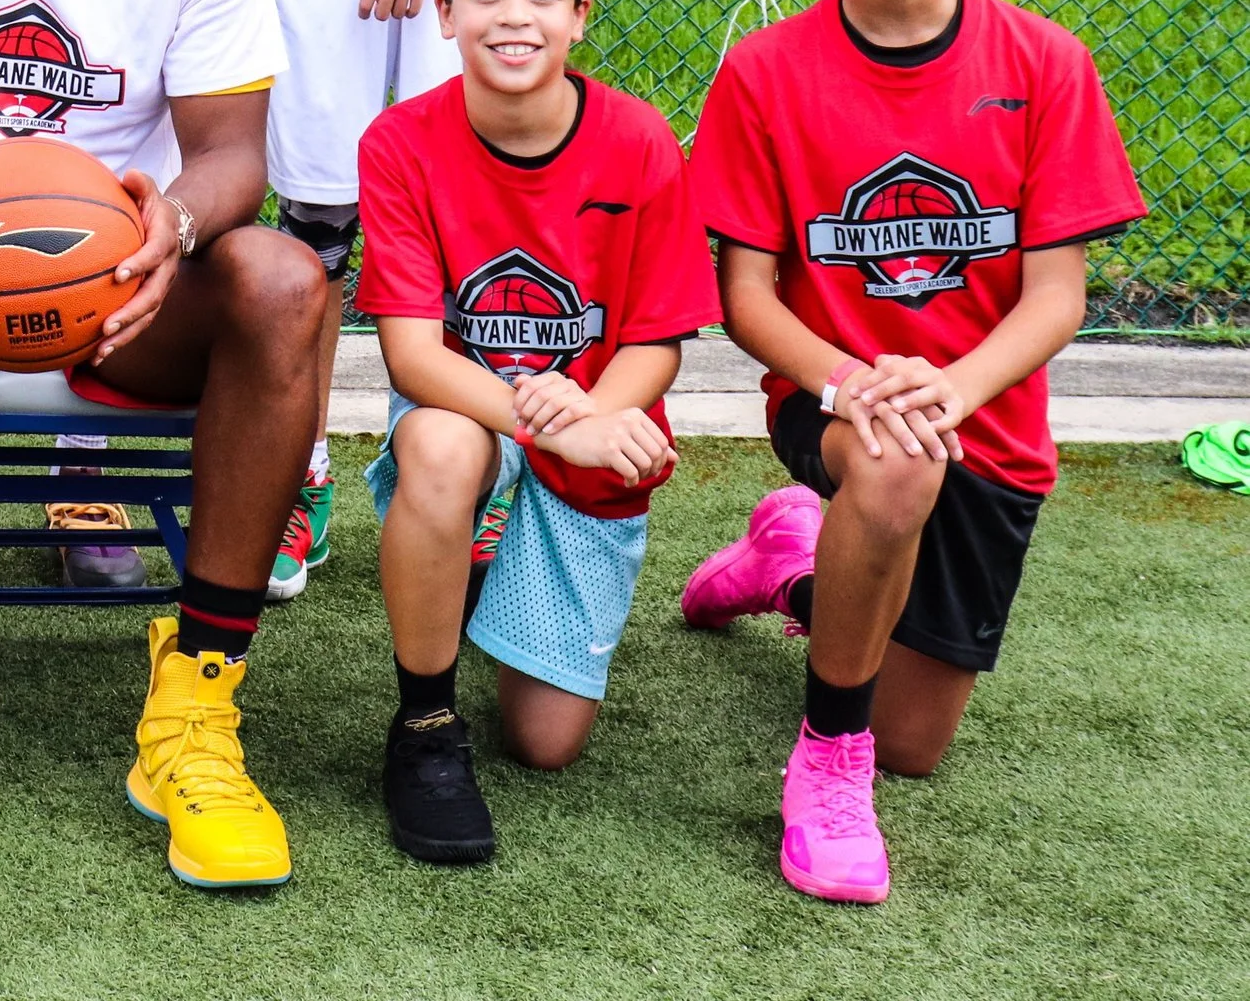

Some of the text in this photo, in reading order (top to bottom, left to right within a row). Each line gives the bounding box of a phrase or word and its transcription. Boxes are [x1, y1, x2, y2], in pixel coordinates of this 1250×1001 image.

[42, 65, 96, 98] WADE
[10, 118, 29, 127] SPORTS
[29, 119, 56, 130] ACADEMY
[834, 220, 992, 252] DWYANE WADE
[874, 278, 957, 296] CELEBRITY SPORTS ACADEMY
[5, 309, 63, 335] FIBA
[459, 316, 586, 346] WYANE WADE
[9, 331, 63, 345] APPROVED
